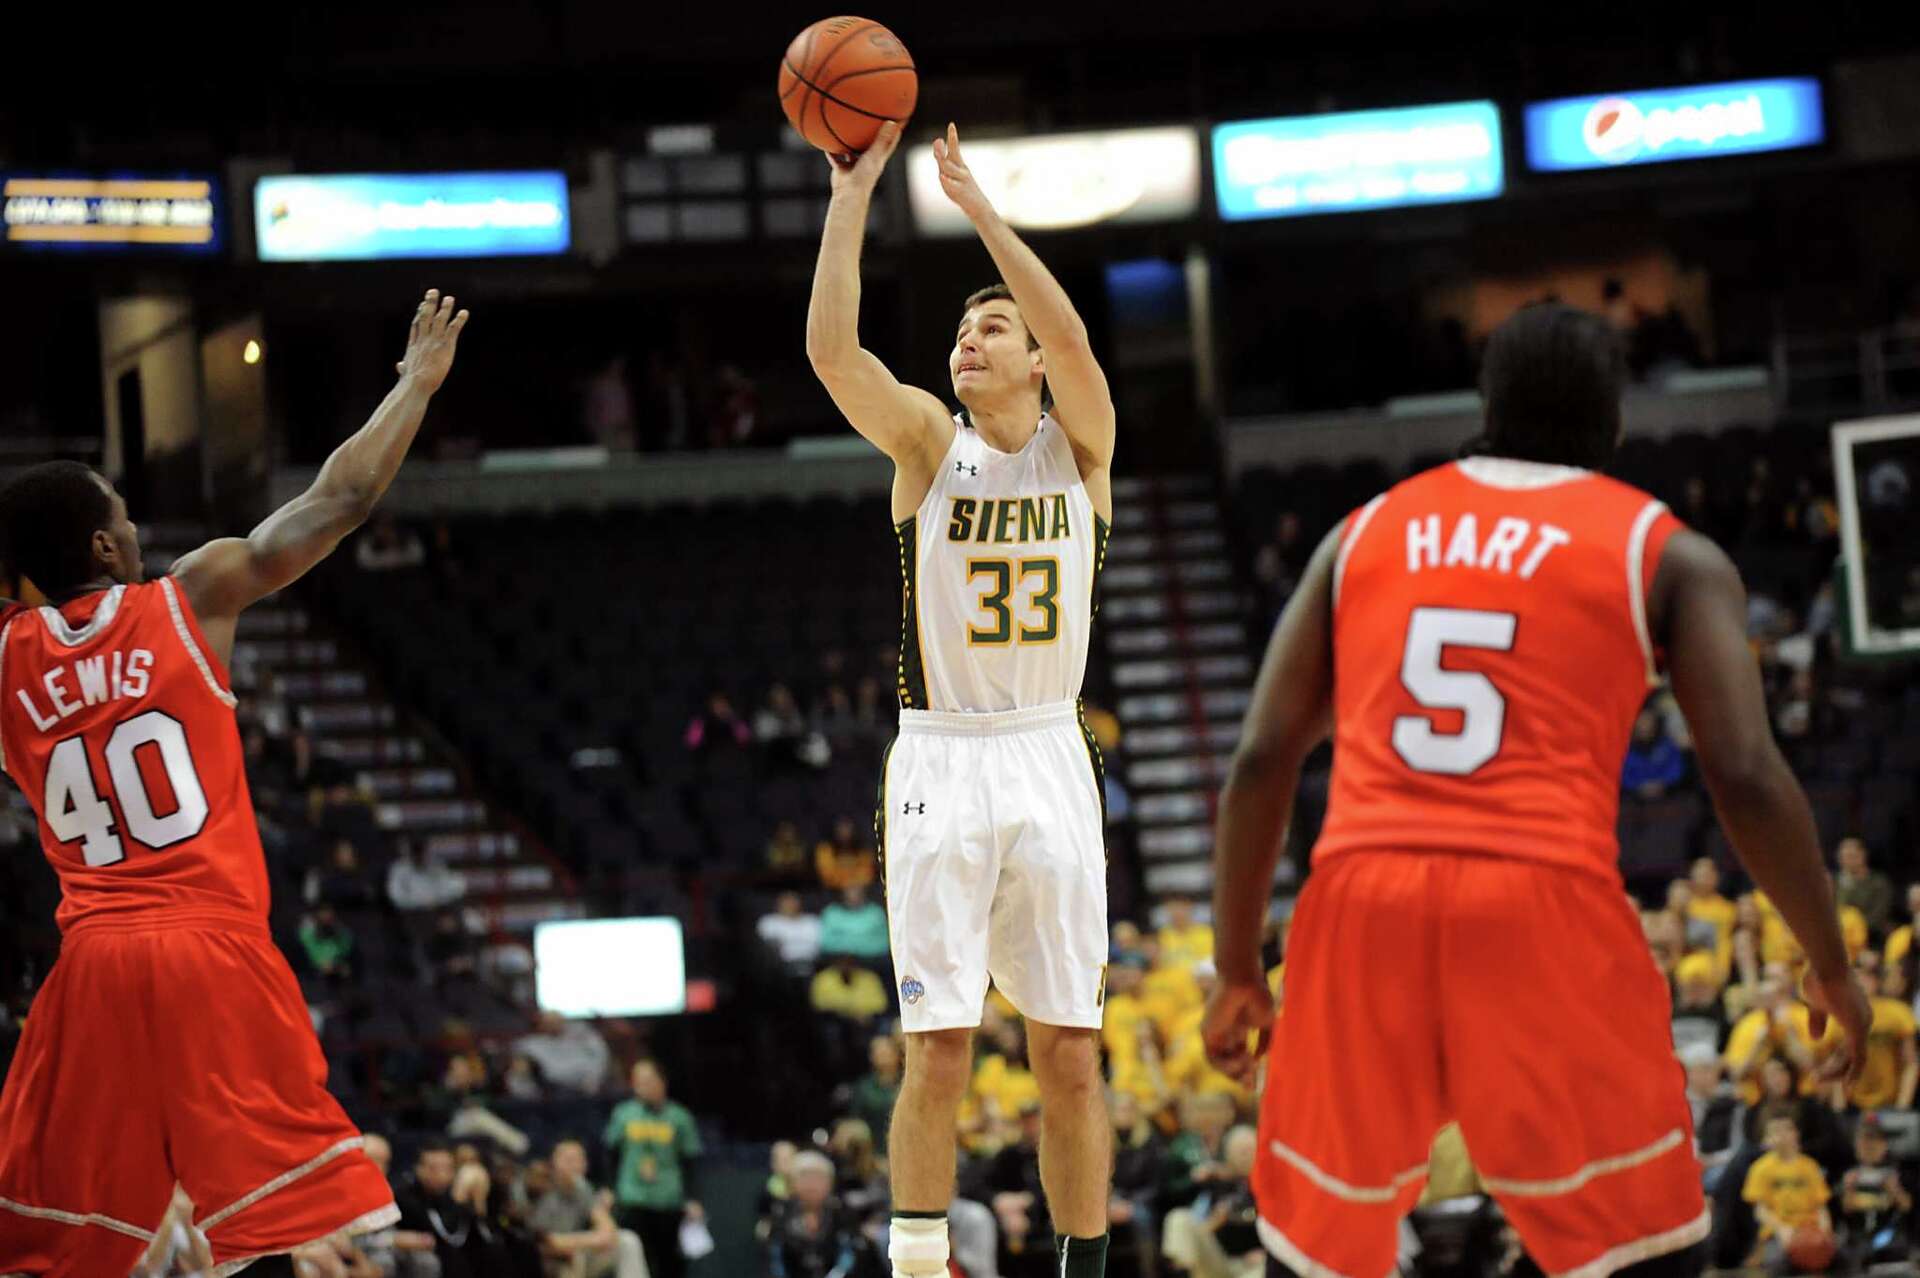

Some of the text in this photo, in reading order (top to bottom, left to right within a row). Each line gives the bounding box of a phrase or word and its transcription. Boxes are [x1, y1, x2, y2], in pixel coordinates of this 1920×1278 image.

[948, 493, 1071, 543] SIENA
[1405, 512, 1571, 579] HART
[966, 557, 1061, 647] 33
[17, 649, 154, 732] LEWIS
[1391, 605, 1518, 776] 5
[45, 708, 209, 868] 40
